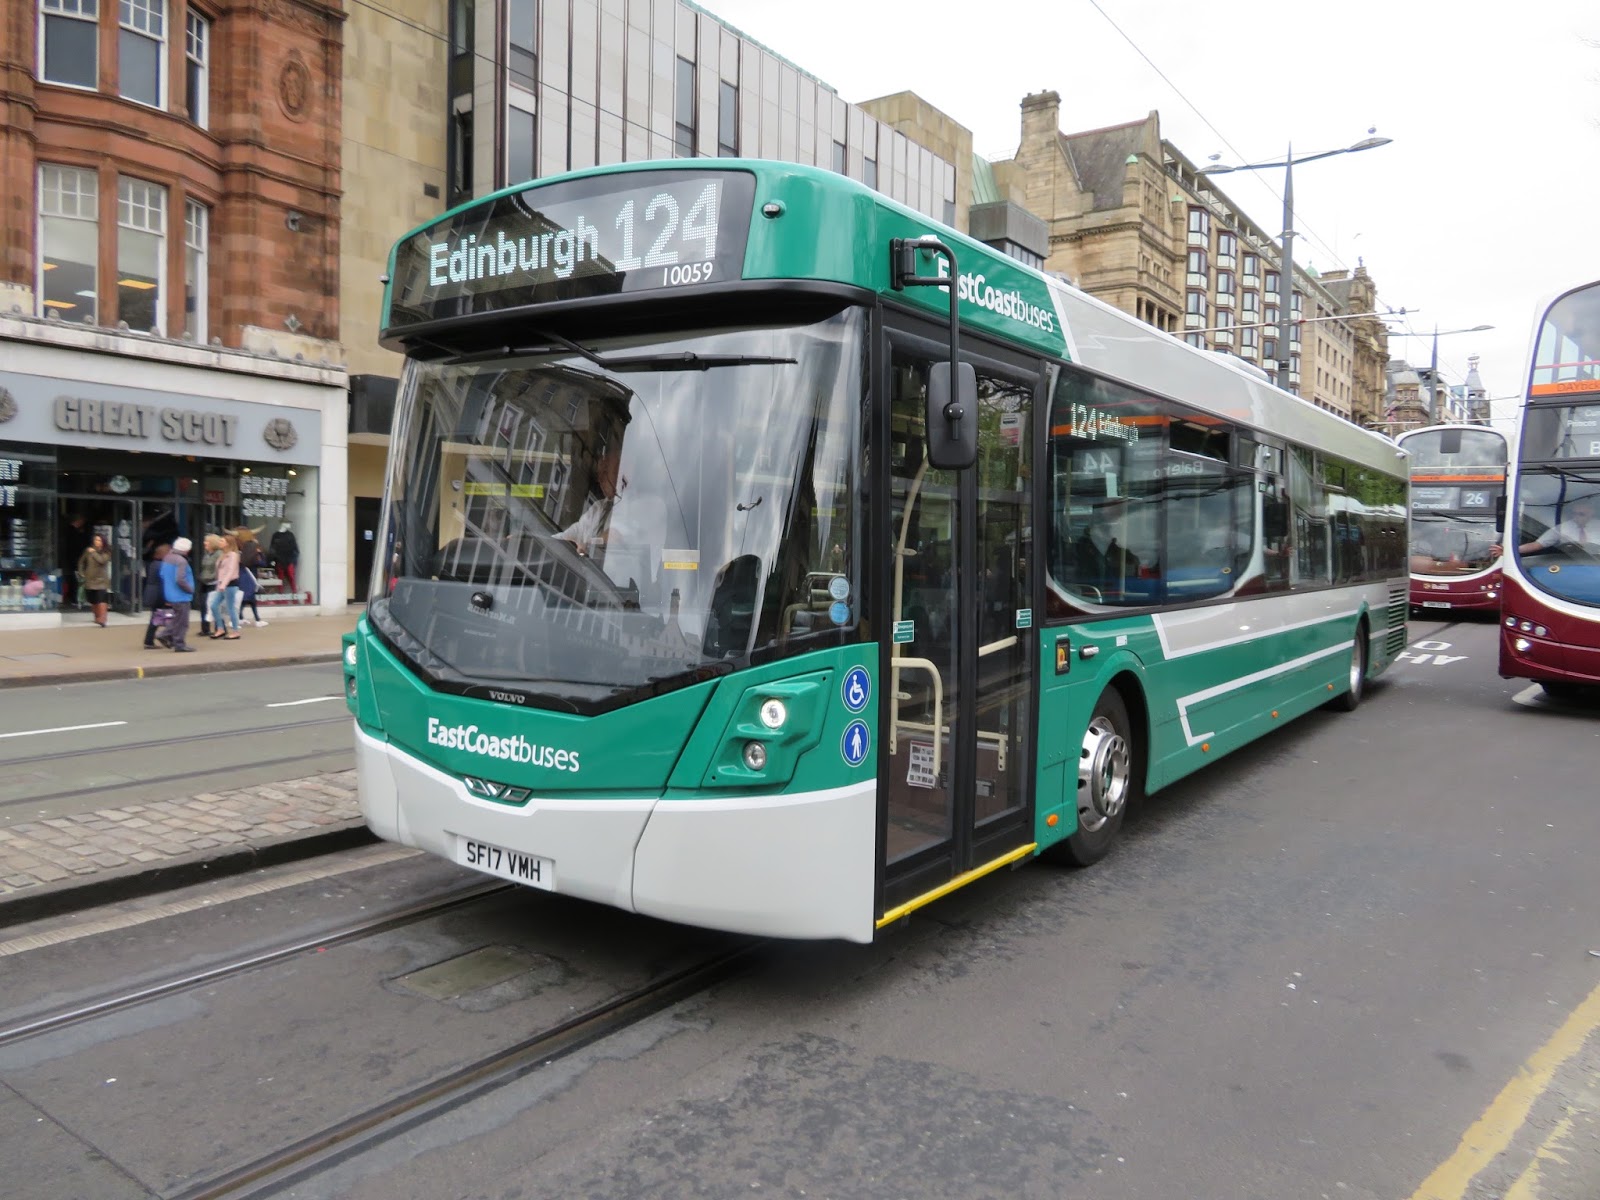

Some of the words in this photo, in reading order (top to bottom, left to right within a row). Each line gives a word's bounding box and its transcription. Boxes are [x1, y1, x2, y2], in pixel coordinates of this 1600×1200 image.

[430, 215, 598, 286] Edinburgh
[614, 183, 718, 272] 124
[662, 262, 713, 286] 10059
[937, 256, 1054, 333] EstCoastbuses
[54, 395, 154, 439] GREAT
[161, 407, 239, 447] SCOT
[1071, 402, 1097, 440] 124
[1465, 492, 1485, 505] 26
[489, 690, 525, 704] VOLVO
[428, 717, 580, 772] EastCoastbuses
[467, 842, 502, 871] SF17
[508, 853, 541, 882] VMH
